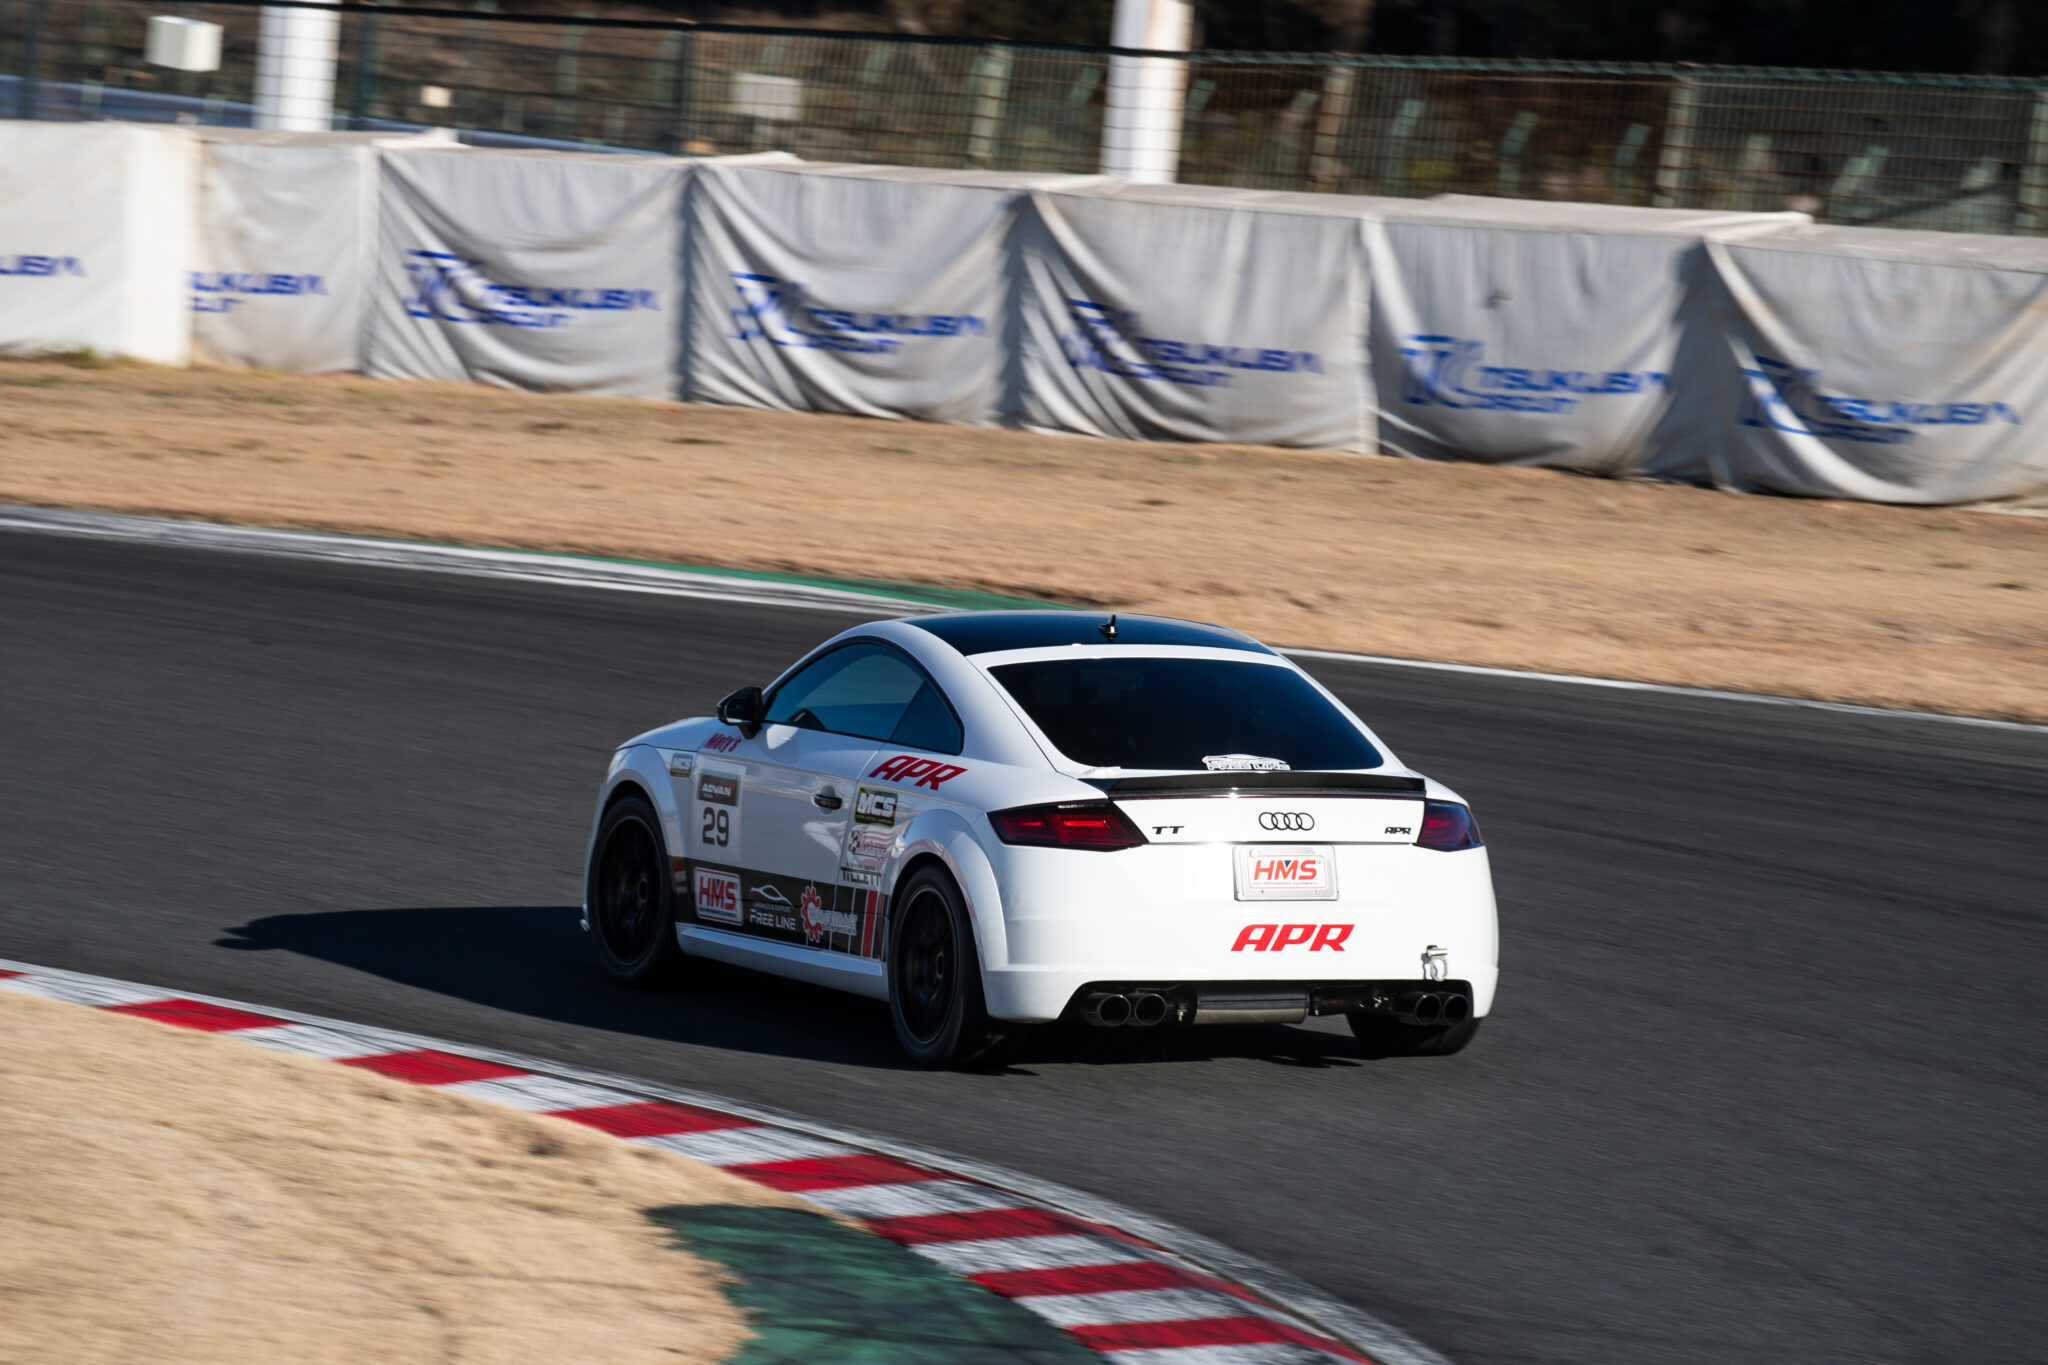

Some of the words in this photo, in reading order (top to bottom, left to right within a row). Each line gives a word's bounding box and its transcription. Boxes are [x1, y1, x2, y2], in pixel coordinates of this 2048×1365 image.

[868, 755, 968, 791] APR
[701, 783, 732, 797] ADVAN
[857, 793, 896, 818] MCS
[702, 807, 729, 847] 29
[1152, 825, 1184, 834] TT
[1384, 826, 1411, 835] APR
[1253, 859, 1318, 881] HMS
[699, 876, 736, 911] HMS
[749, 908, 774, 927] FREE
[775, 914, 796, 931] LINE
[1230, 923, 1355, 952] APR
